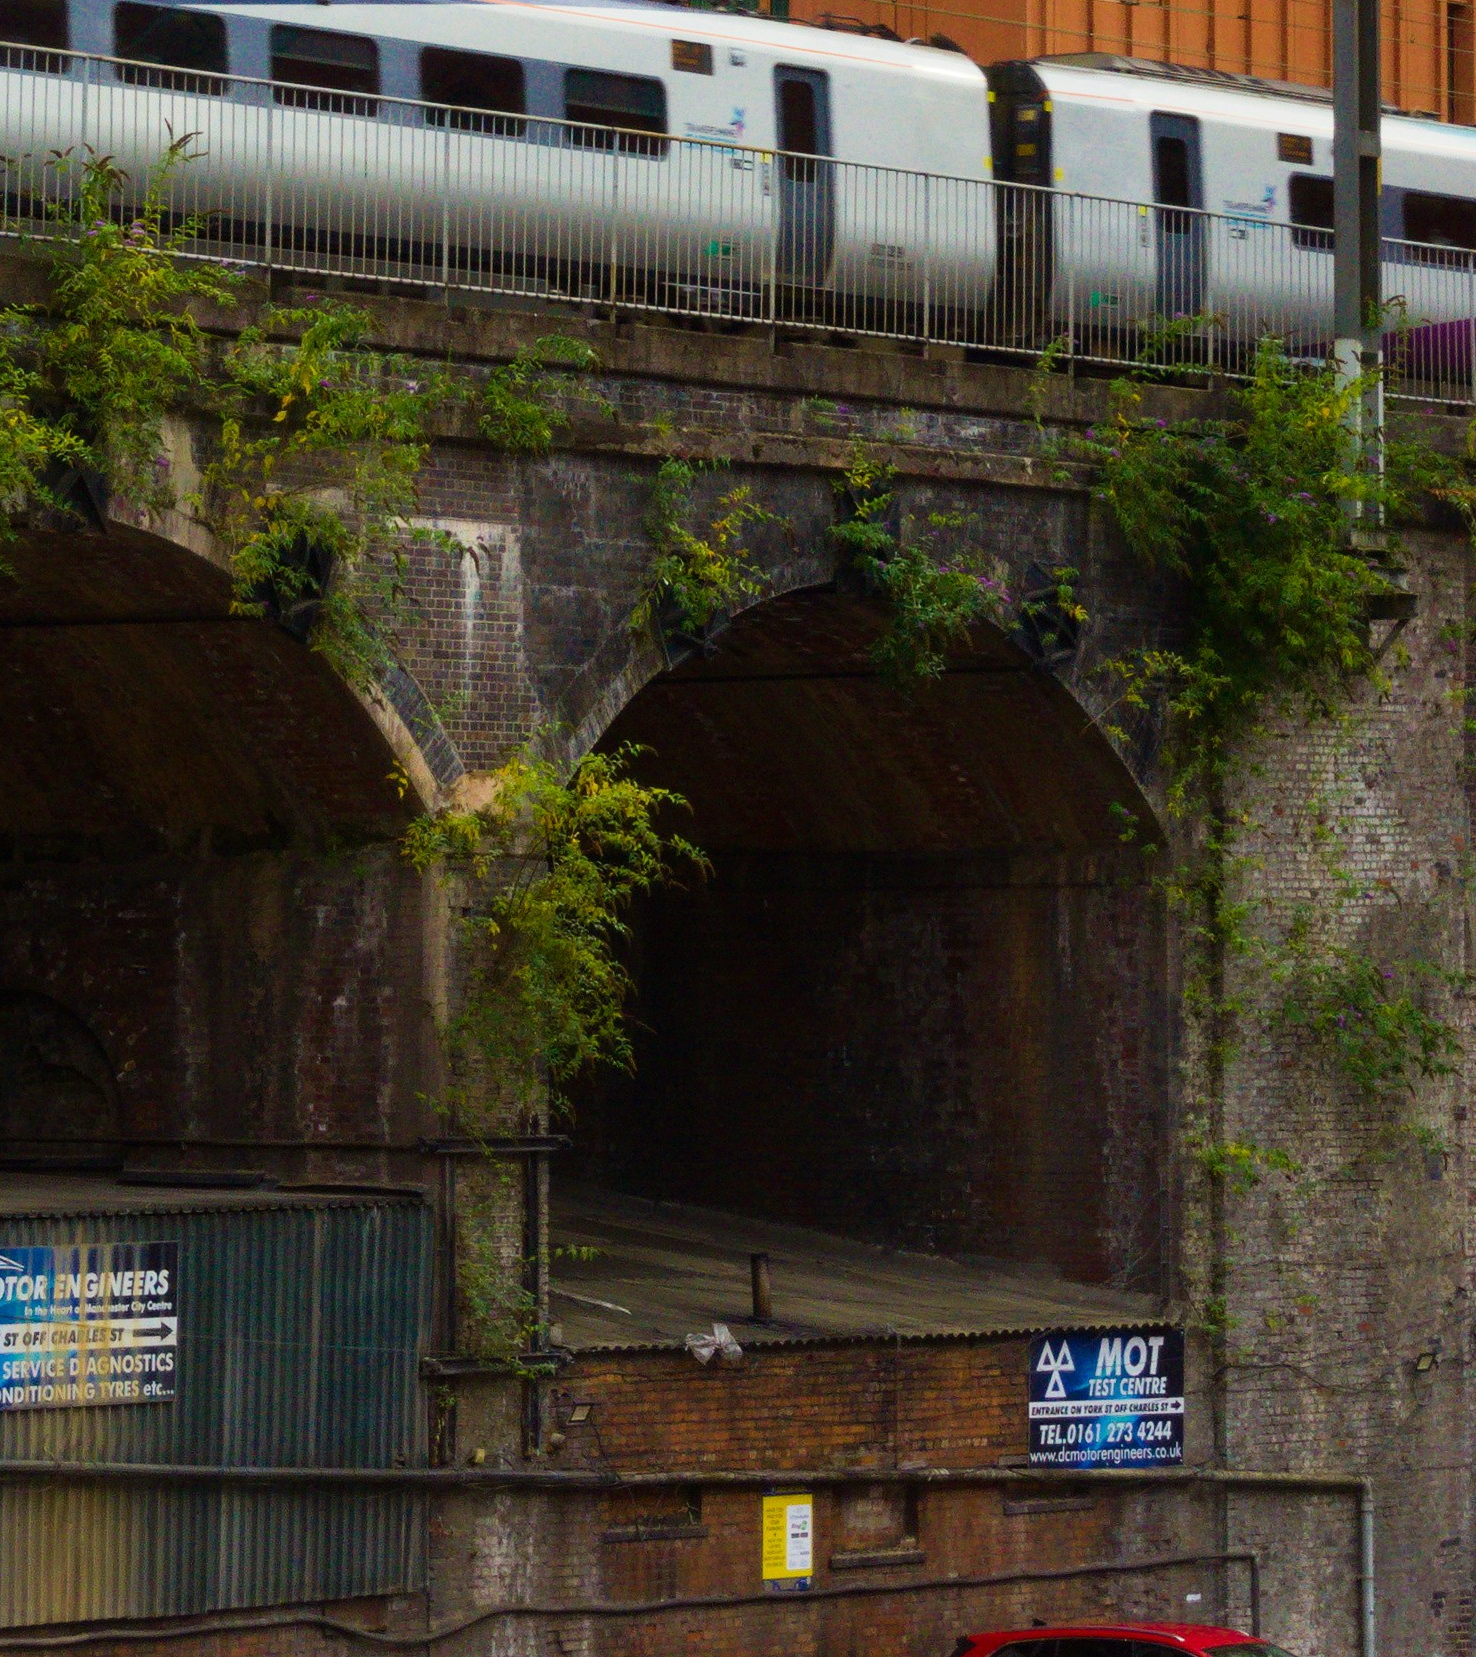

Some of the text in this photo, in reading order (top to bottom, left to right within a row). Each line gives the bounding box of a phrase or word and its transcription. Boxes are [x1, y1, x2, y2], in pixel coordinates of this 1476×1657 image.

[53, 1269, 170, 1299] ENGINEERS
[131, 1301, 145, 1313] City
[147, 1300, 173, 1311] Centre
[4, 1332, 18, 1347] ST
[23, 1331, 47, 1347] OFF
[51, 1328, 106, 1345] CHALES
[110, 1328, 124, 1343] ST
[1095, 1336, 1165, 1377] MOT
[2, 1357, 65, 1380] SERVICE
[98, 1380, 140, 1399] TYRES
[143, 1380, 175, 1396] etc...
[1088, 1376, 1168, 1397] TEST CENTRE
[1031, 1402, 1169, 1416] ENTRANCE ON YORK ST OFF CHARLES ST
[1039, 1420, 1173, 1445] TEL.0161 273 4244
[1029, 1441, 1183, 1465] www.dcmotorengineers.co.uk
